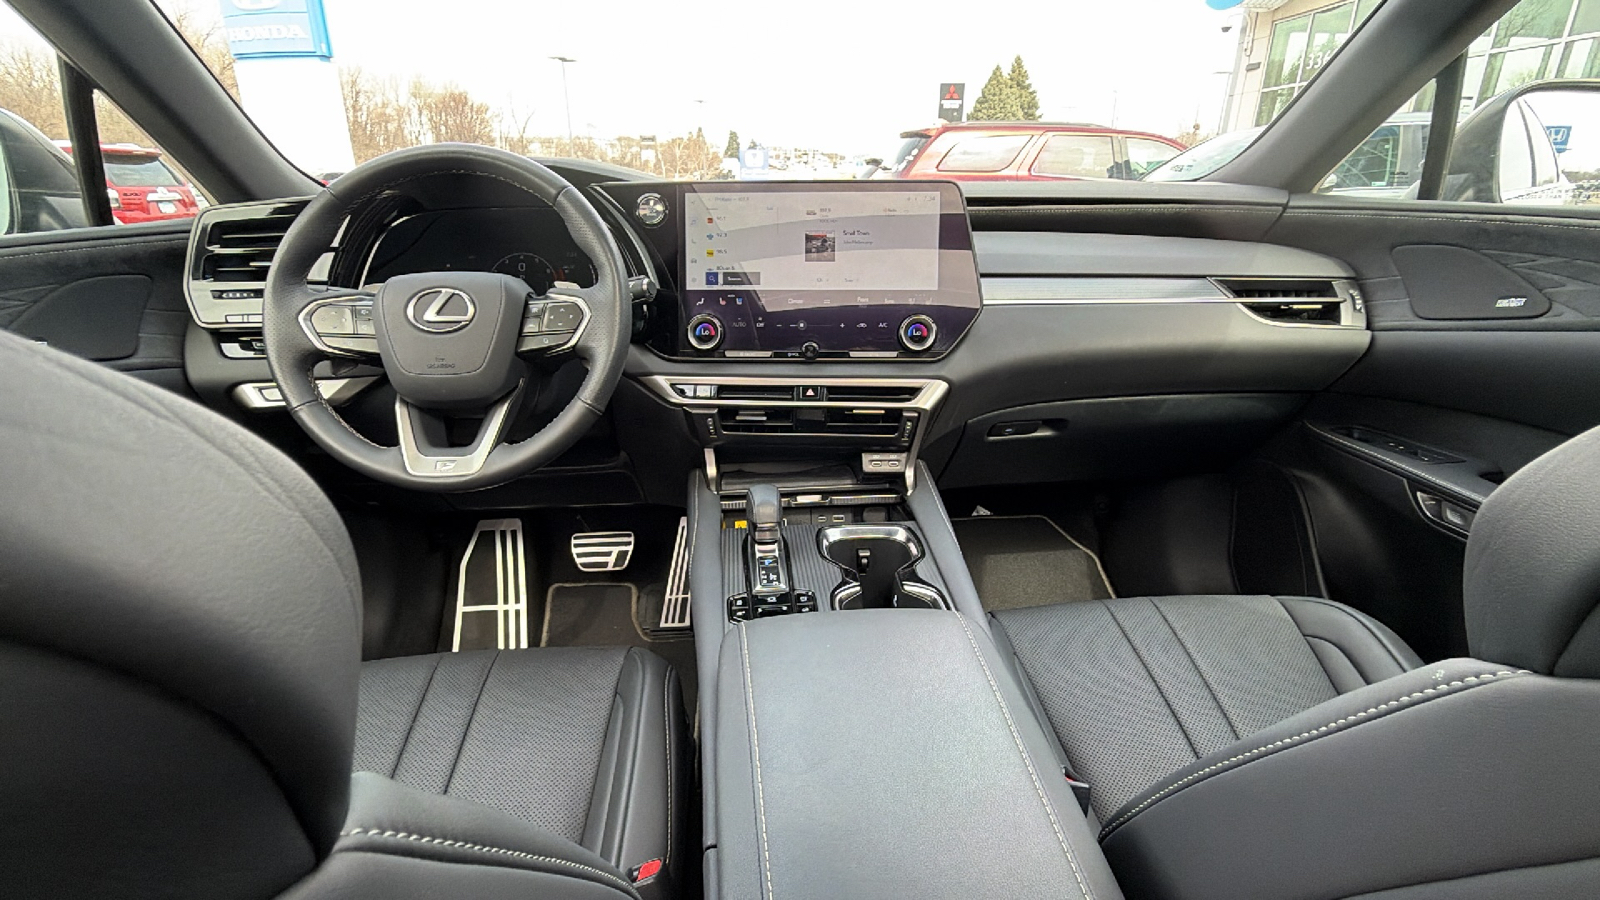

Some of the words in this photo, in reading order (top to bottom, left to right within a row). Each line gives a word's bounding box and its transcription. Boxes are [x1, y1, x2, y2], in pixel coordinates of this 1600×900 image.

[228, 25, 309, 42] HONDA
[701, 327, 710, 336] Lo
[913, 328, 922, 336] Lo
